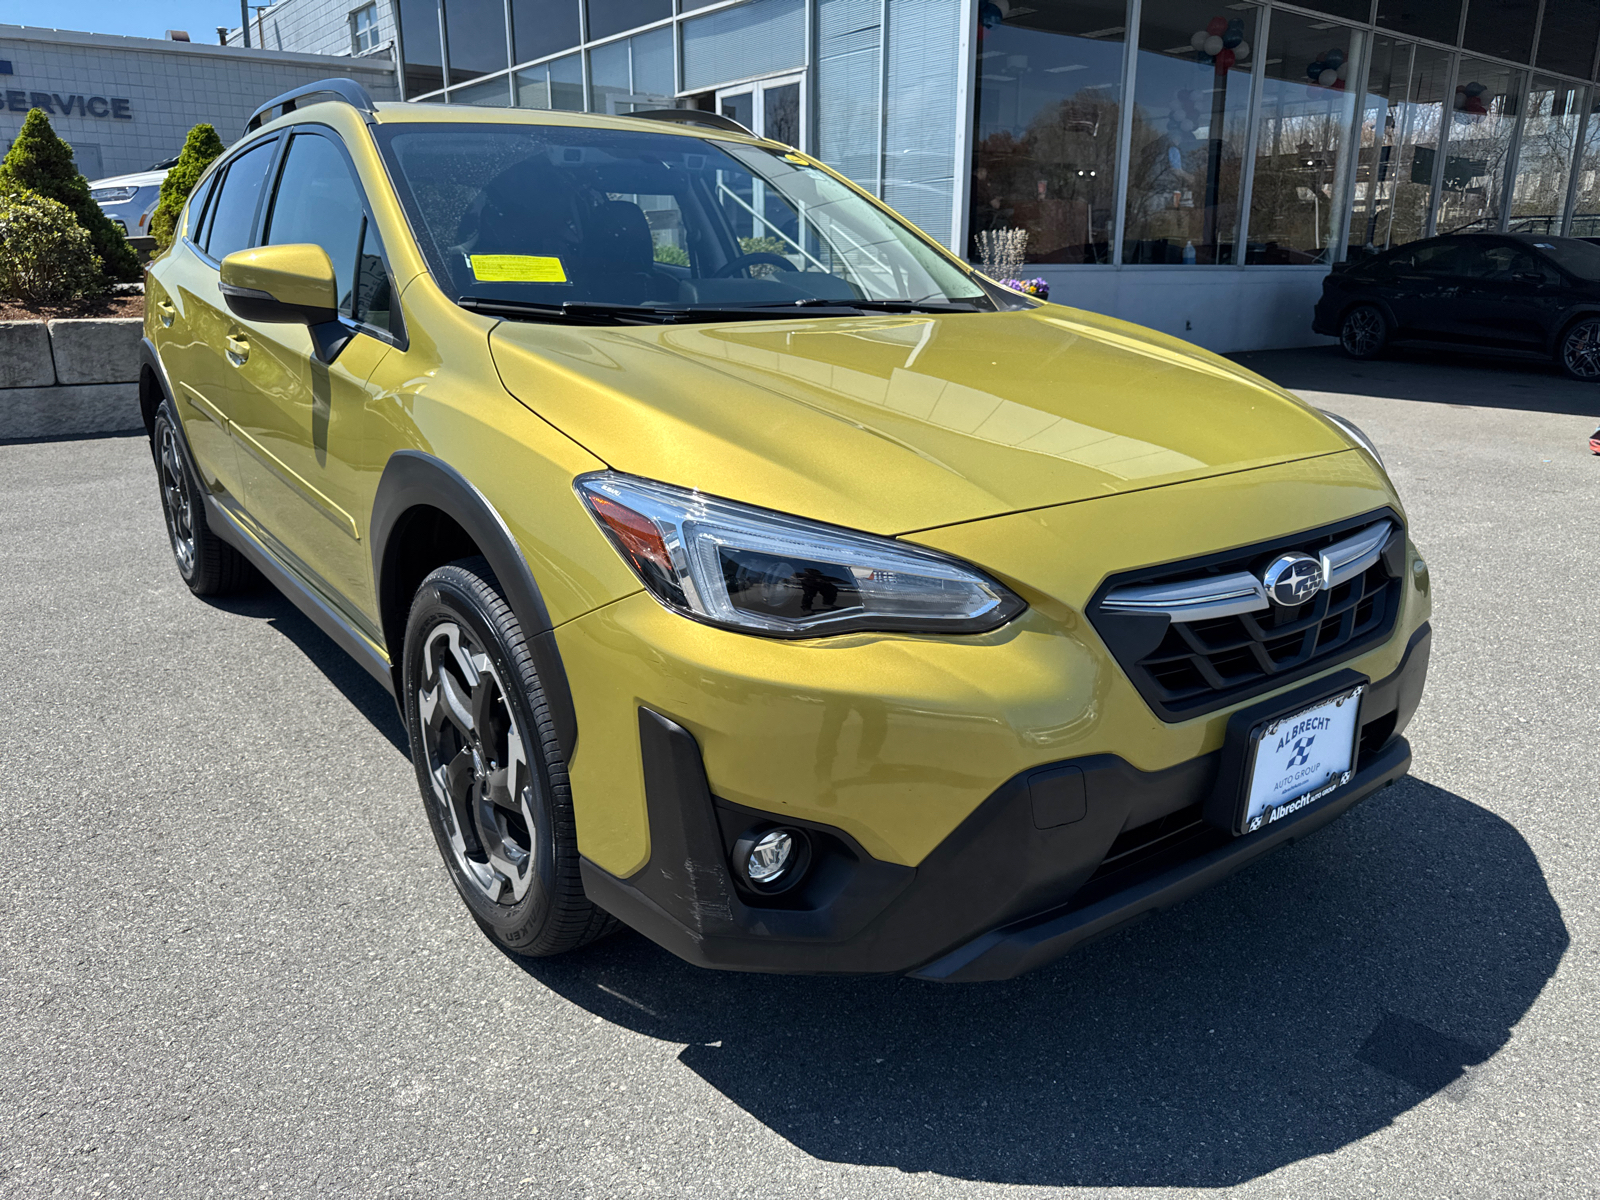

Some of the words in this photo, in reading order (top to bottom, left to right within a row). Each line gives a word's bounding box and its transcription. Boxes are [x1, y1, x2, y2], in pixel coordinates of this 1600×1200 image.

[0, 90, 132, 119] ERVICE
[1275, 717, 1331, 753] ALBRECHT
[1273, 775, 1293, 791] AUTO
[1294, 762, 1321, 780] GROUP
[1268, 792, 1310, 824] Albrecht
